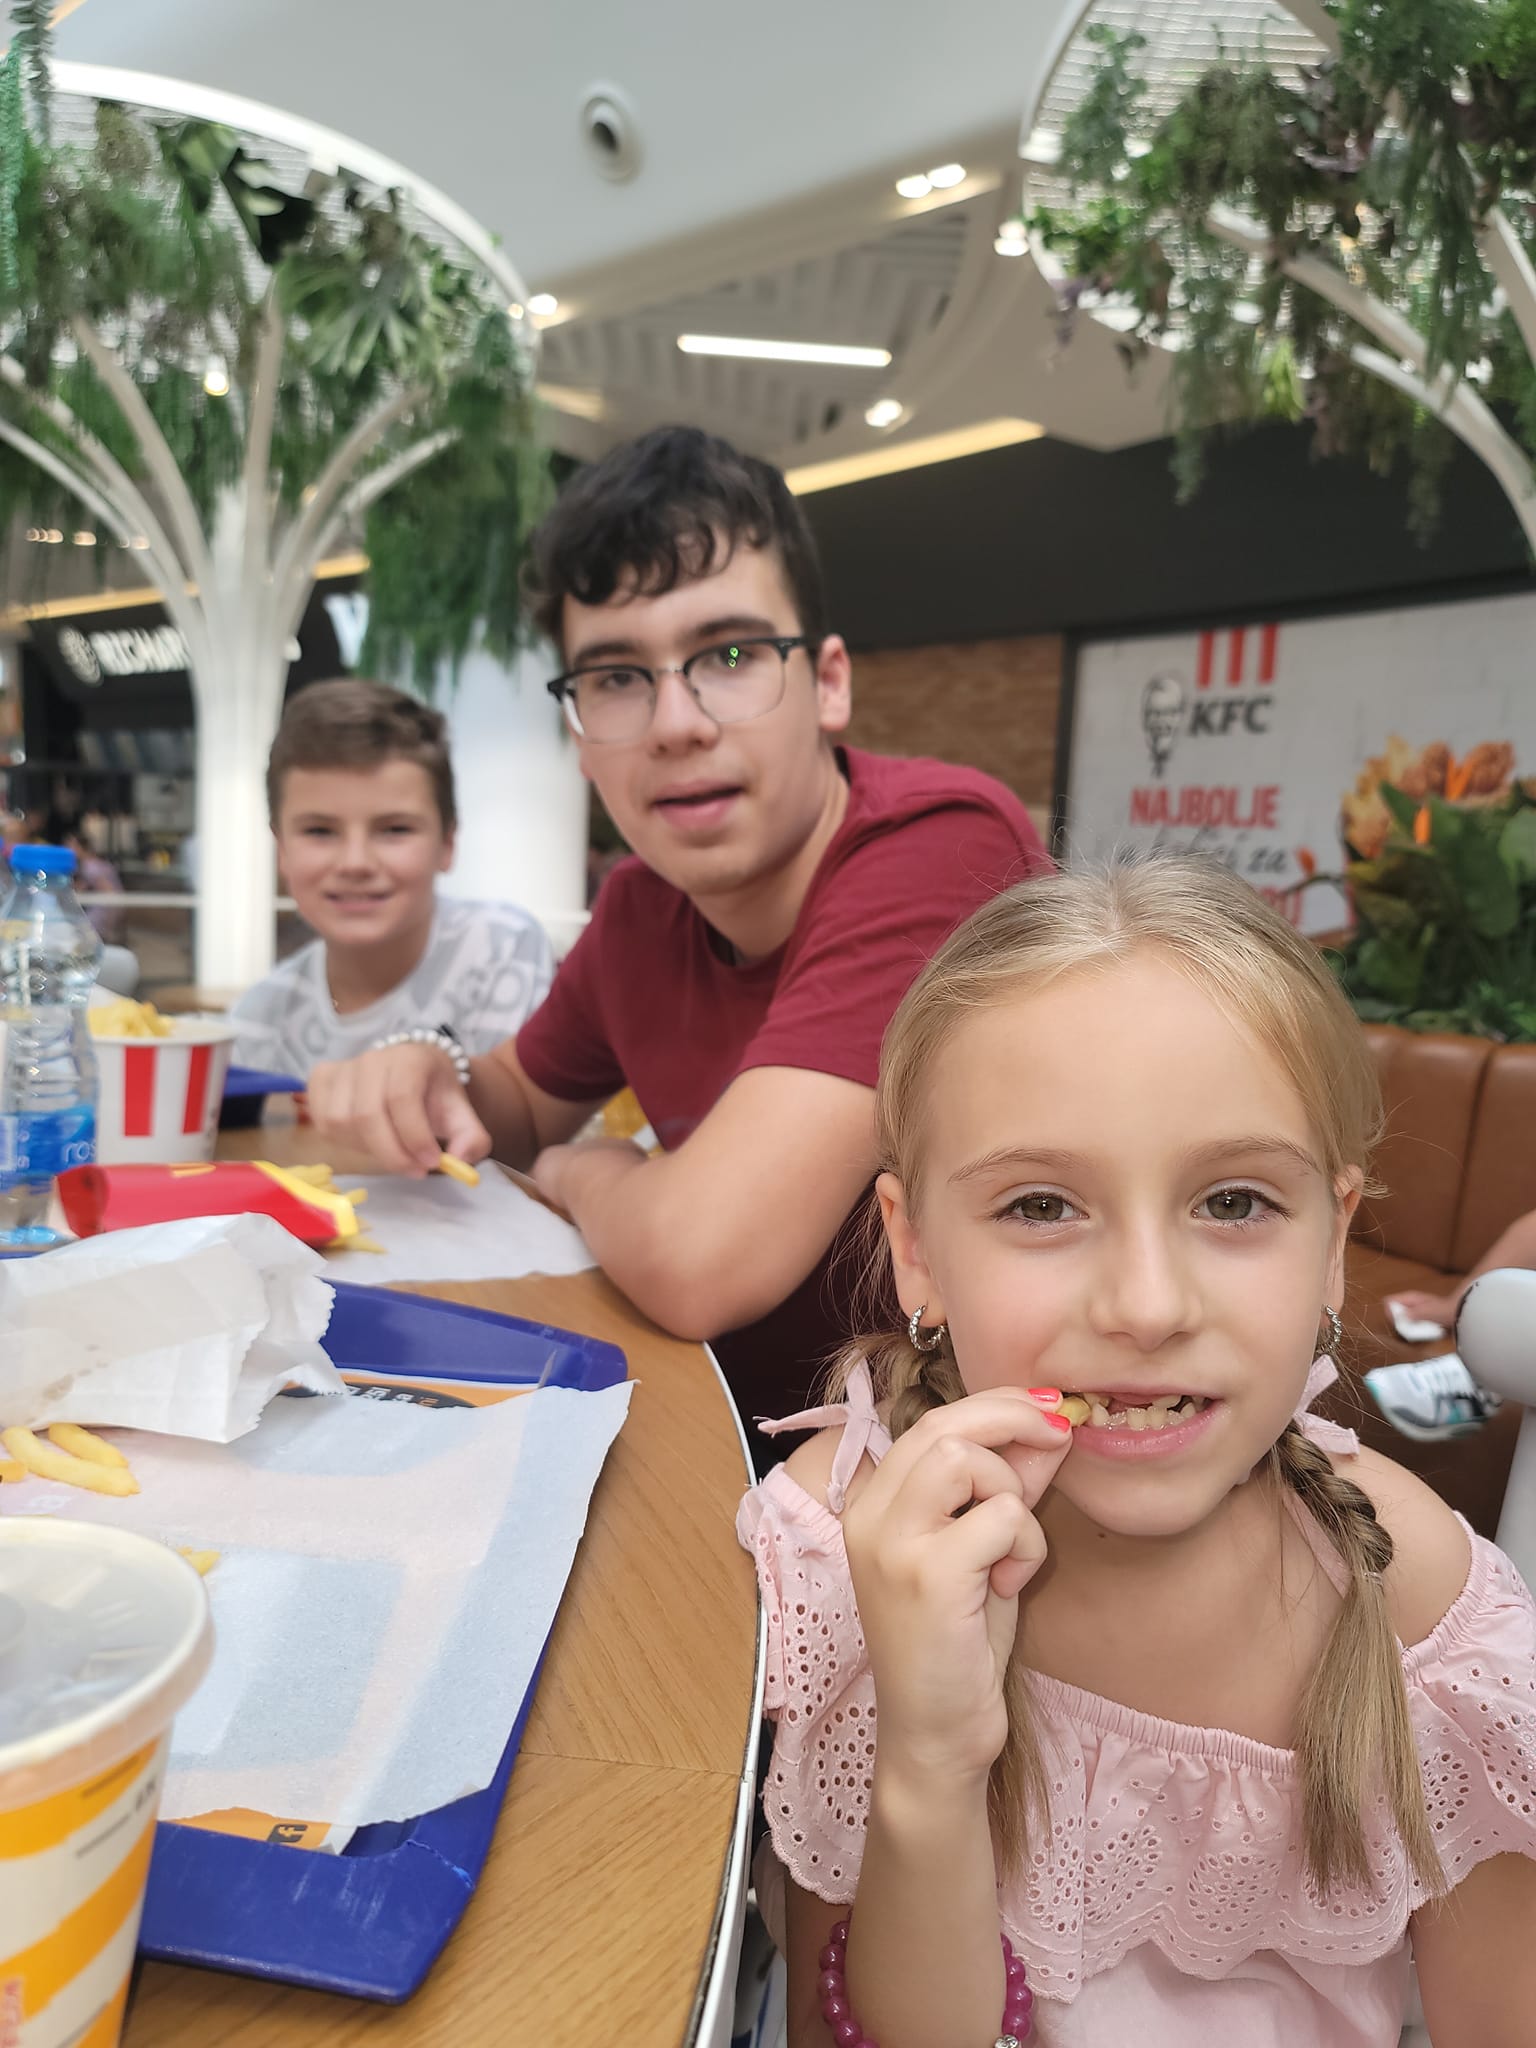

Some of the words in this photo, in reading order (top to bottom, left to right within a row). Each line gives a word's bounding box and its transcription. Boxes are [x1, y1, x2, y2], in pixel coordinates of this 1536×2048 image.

[1186, 697, 1273, 738] KFC
[1131, 785, 1281, 830] NAJBOLJE
[1247, 846, 1288, 875] za
